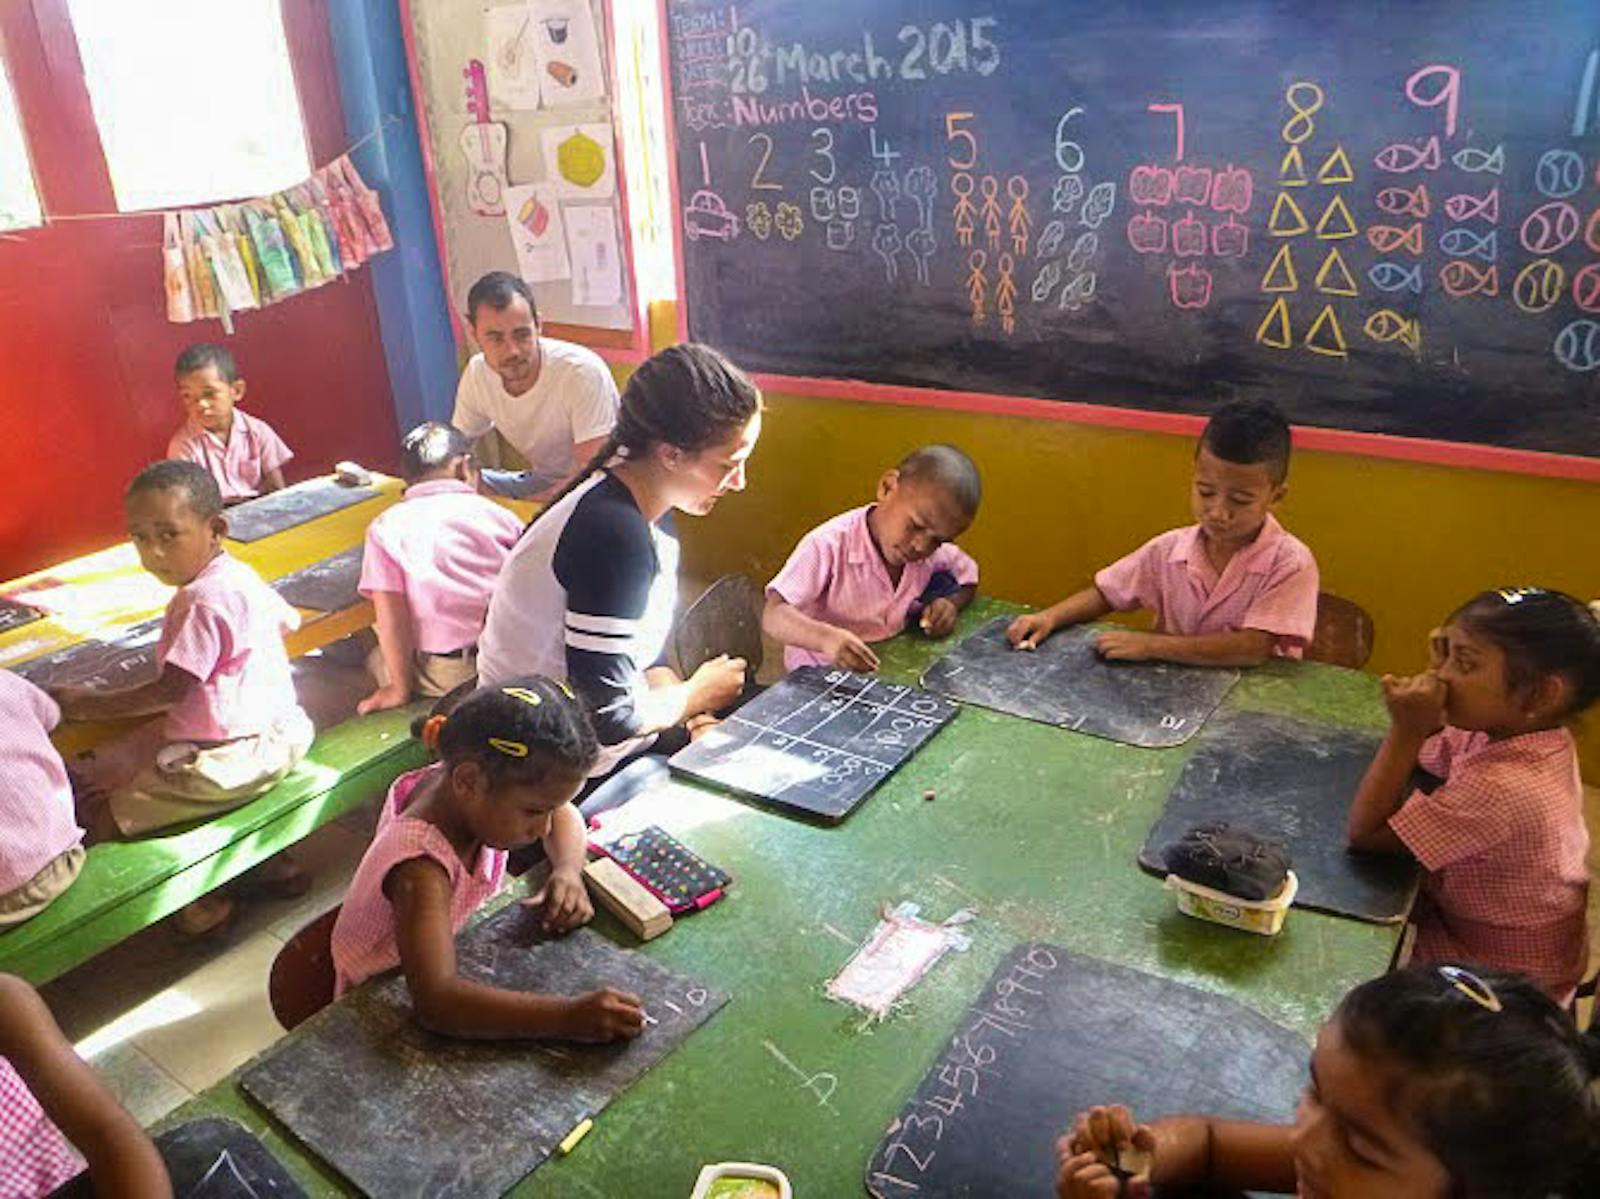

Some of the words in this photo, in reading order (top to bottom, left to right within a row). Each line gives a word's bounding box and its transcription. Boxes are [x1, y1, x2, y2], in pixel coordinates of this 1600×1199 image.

[776, 30, 893, 86] March
[897, 16, 1000, 80] 2015
[731, 85, 879, 126] Numbers
[748, 132, 783, 190] 2
[809, 127, 836, 184] 3
[869, 127, 901, 167] 4
[944, 112, 977, 170] 5
[1055, 107, 1085, 172] 6
[1147, 104, 1184, 160] 7
[1281, 81, 1324, 144] 8
[1405, 64, 1461, 138] 9
[1571, 50, 1600, 137] 1
